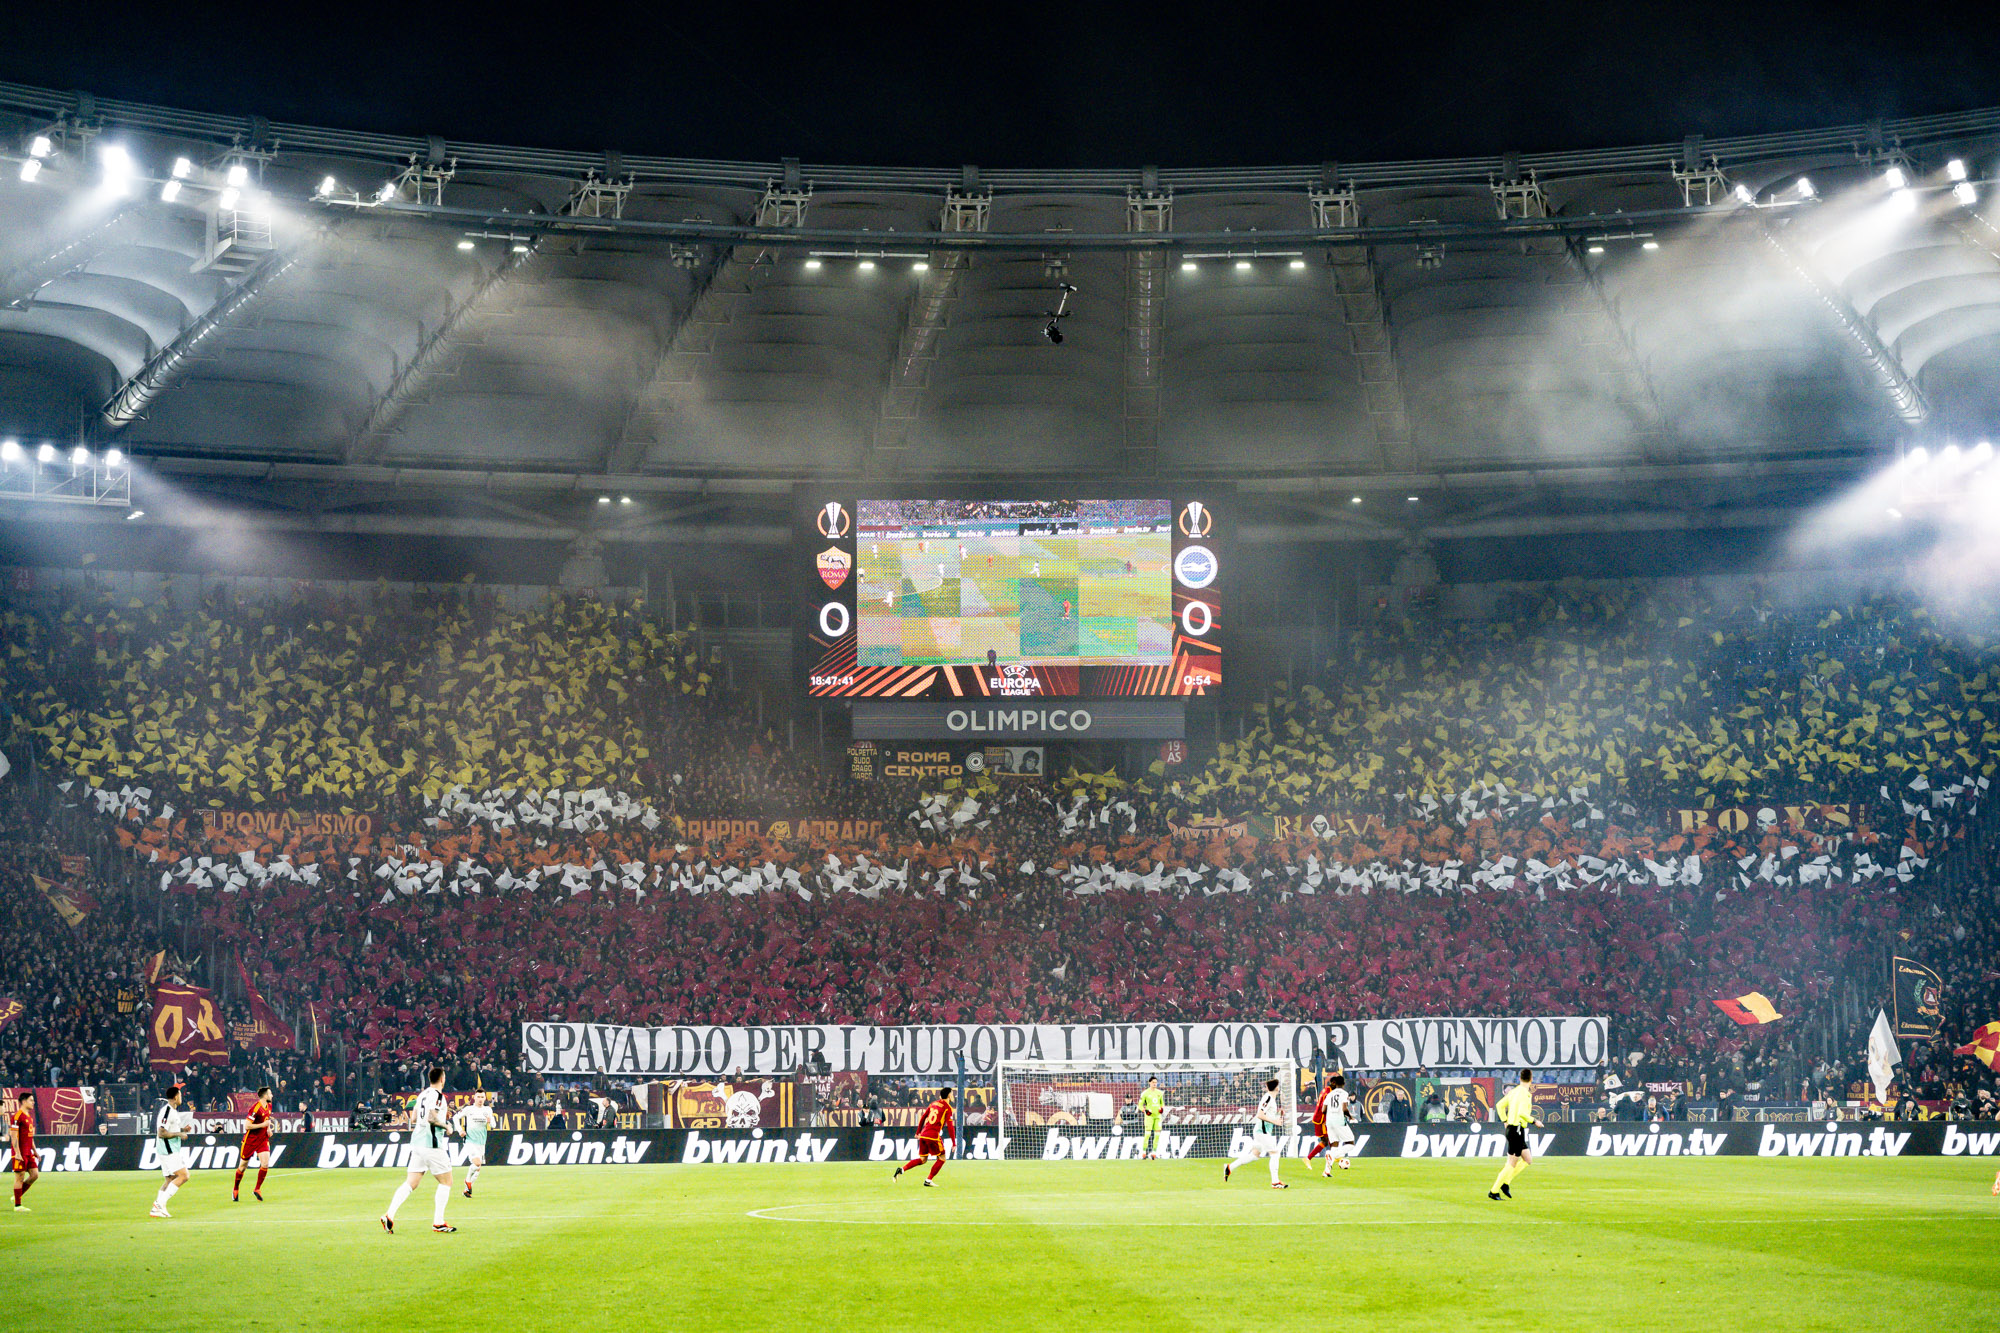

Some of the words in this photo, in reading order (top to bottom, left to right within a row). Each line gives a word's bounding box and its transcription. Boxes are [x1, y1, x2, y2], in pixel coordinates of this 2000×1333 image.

[819, 602, 850, 637] 0
[1182, 601, 1212, 636] 0
[1004, 667, 1027, 676] UEFA
[810, 676, 854, 686] 18:47:41
[990, 677, 1041, 689] EUROPA
[1183, 675, 1212, 686] 0:54
[1000, 688, 1031, 696] LEAGUE
[946, 709, 1092, 732] OLIMPICO
[1168, 740, 1180, 751] 19
[897, 751, 950, 763] ROMA
[1167, 751, 1182, 763] AS
[884, 765, 963, 777] CENTRO
[219, 811, 371, 836] ROMAISMO
[525, 1023, 732, 1074] SPAVALDO
[744, 1026, 826, 1073] PER
[839, 1026, 1045, 1073] L'EUROPA
[1088, 1023, 1194, 1070] TUOI
[1207, 1022, 1376, 1070] COLORI
[1382, 1018, 1605, 1067] SVENTOLO
[1331, 1093, 1340, 1109] 18
[682, 1128, 839, 1164] bwin.tv
[1586, 1123, 1728, 1156] bwin.tv
[1757, 1121, 1912, 1156] bwin.tv
[507, 1131, 652, 1165] bwin.tv
